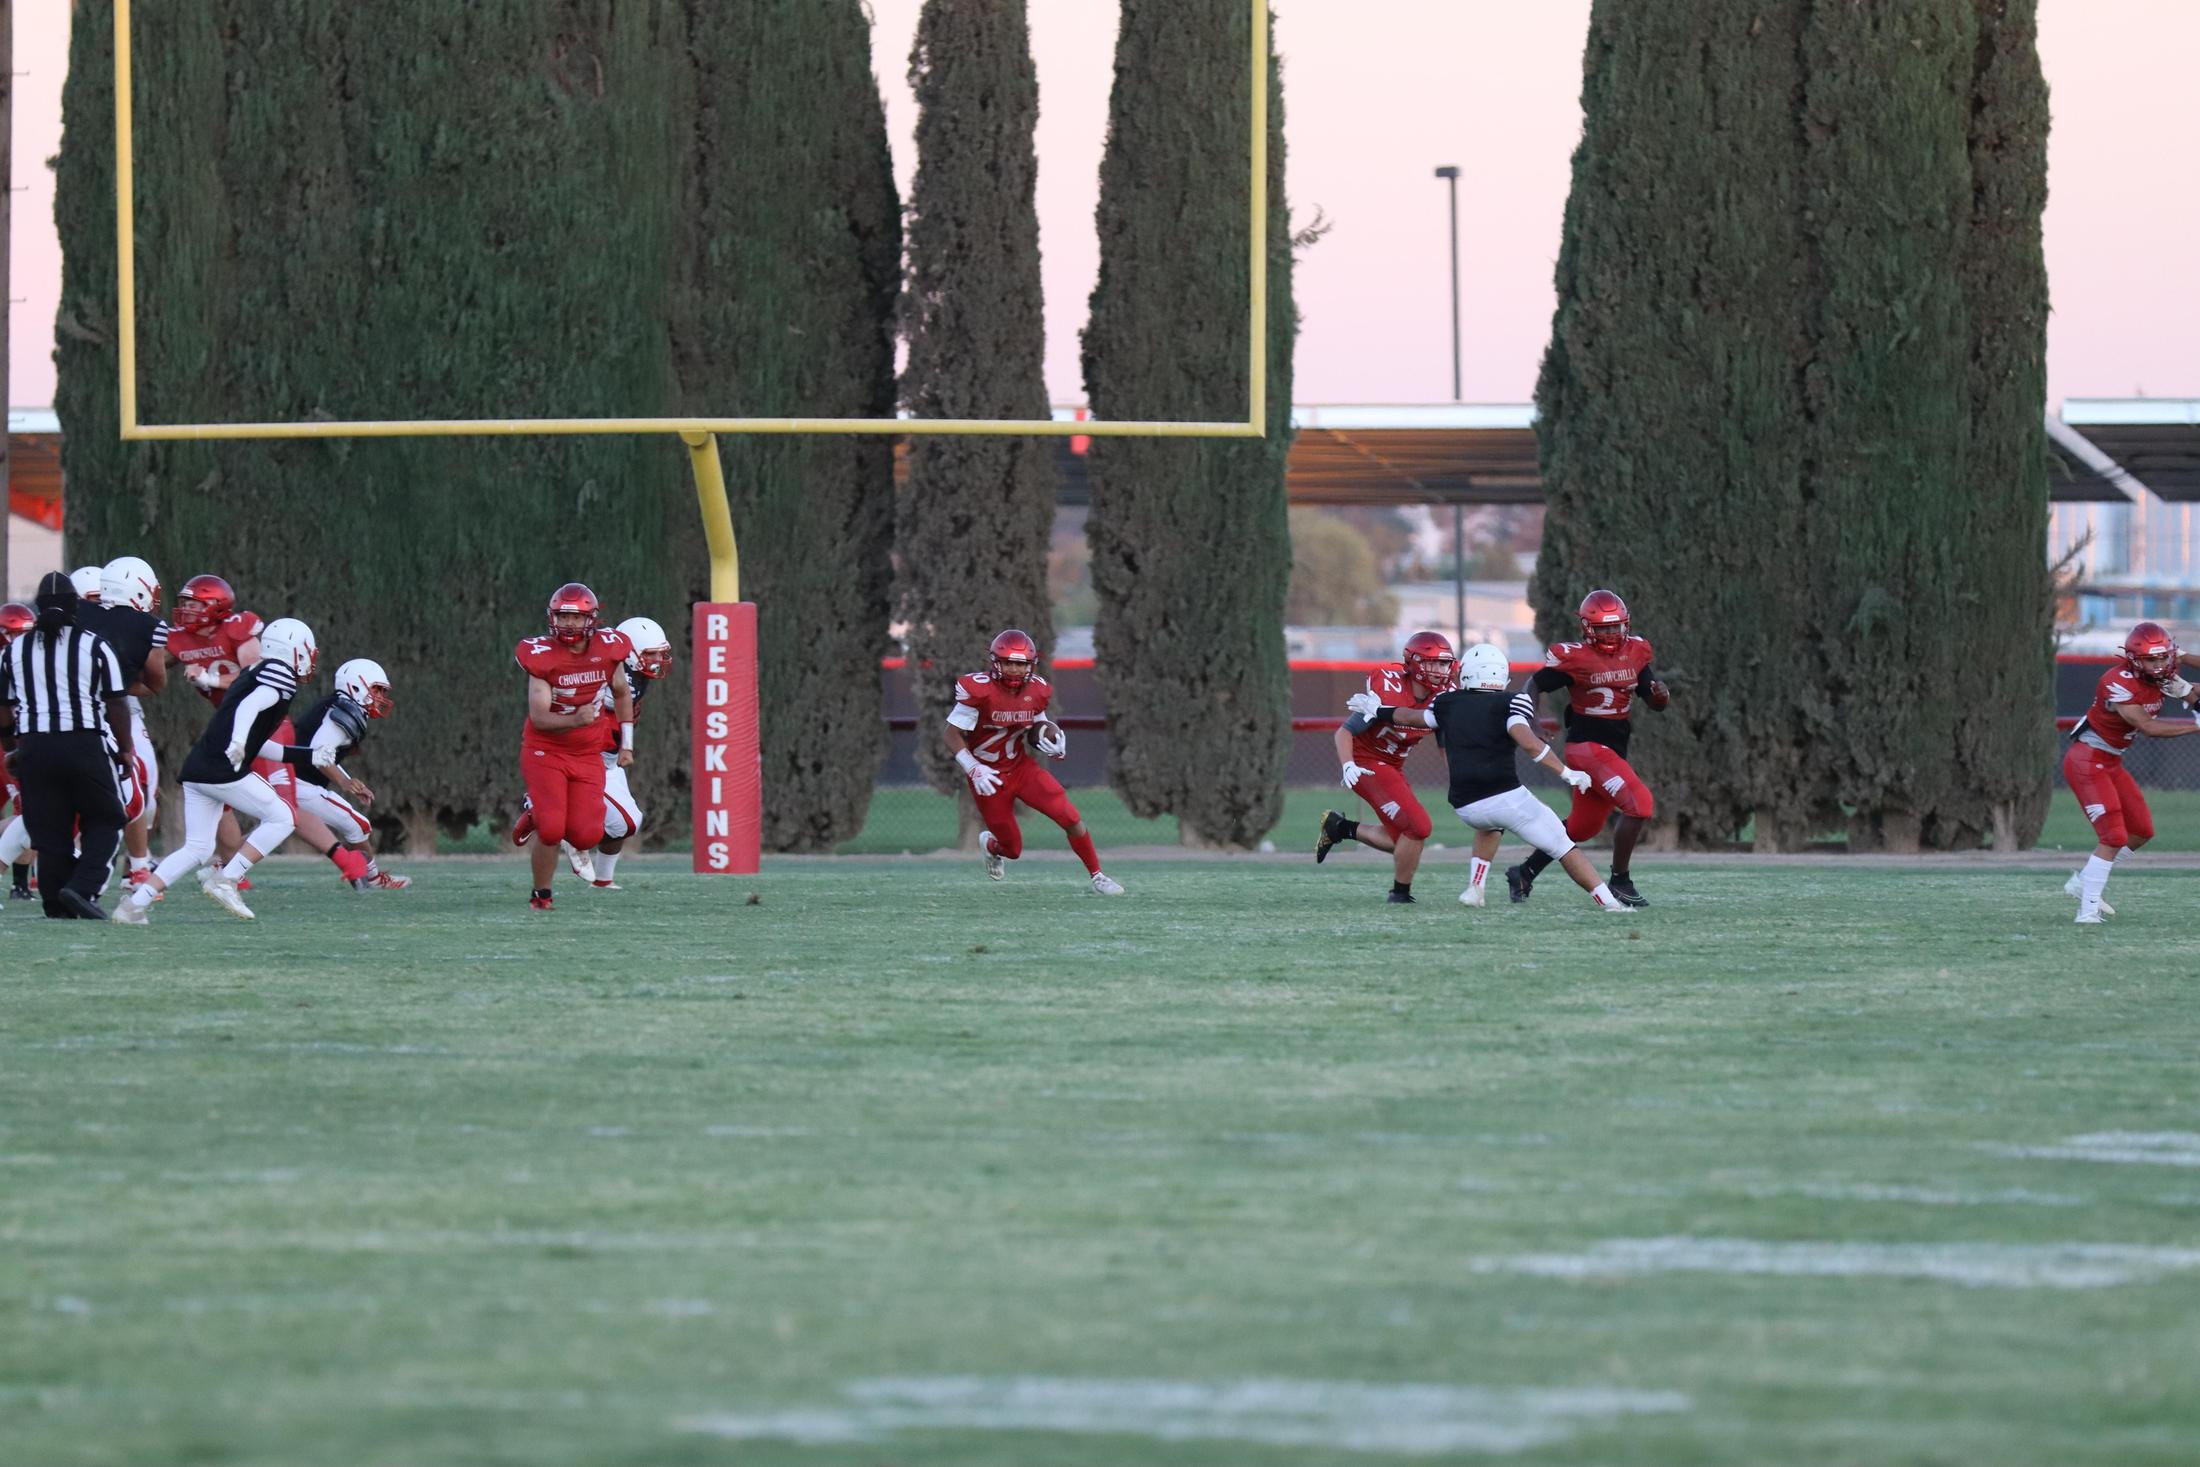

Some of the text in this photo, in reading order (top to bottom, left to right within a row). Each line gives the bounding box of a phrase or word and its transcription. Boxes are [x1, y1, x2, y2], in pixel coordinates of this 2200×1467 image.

[558, 669, 607, 686] CHOWCHILLA
[1380, 667, 1403, 694] 52
[1590, 668, 1637, 684] CHOWCHILLA
[705, 613, 730, 869] REDSKINS
